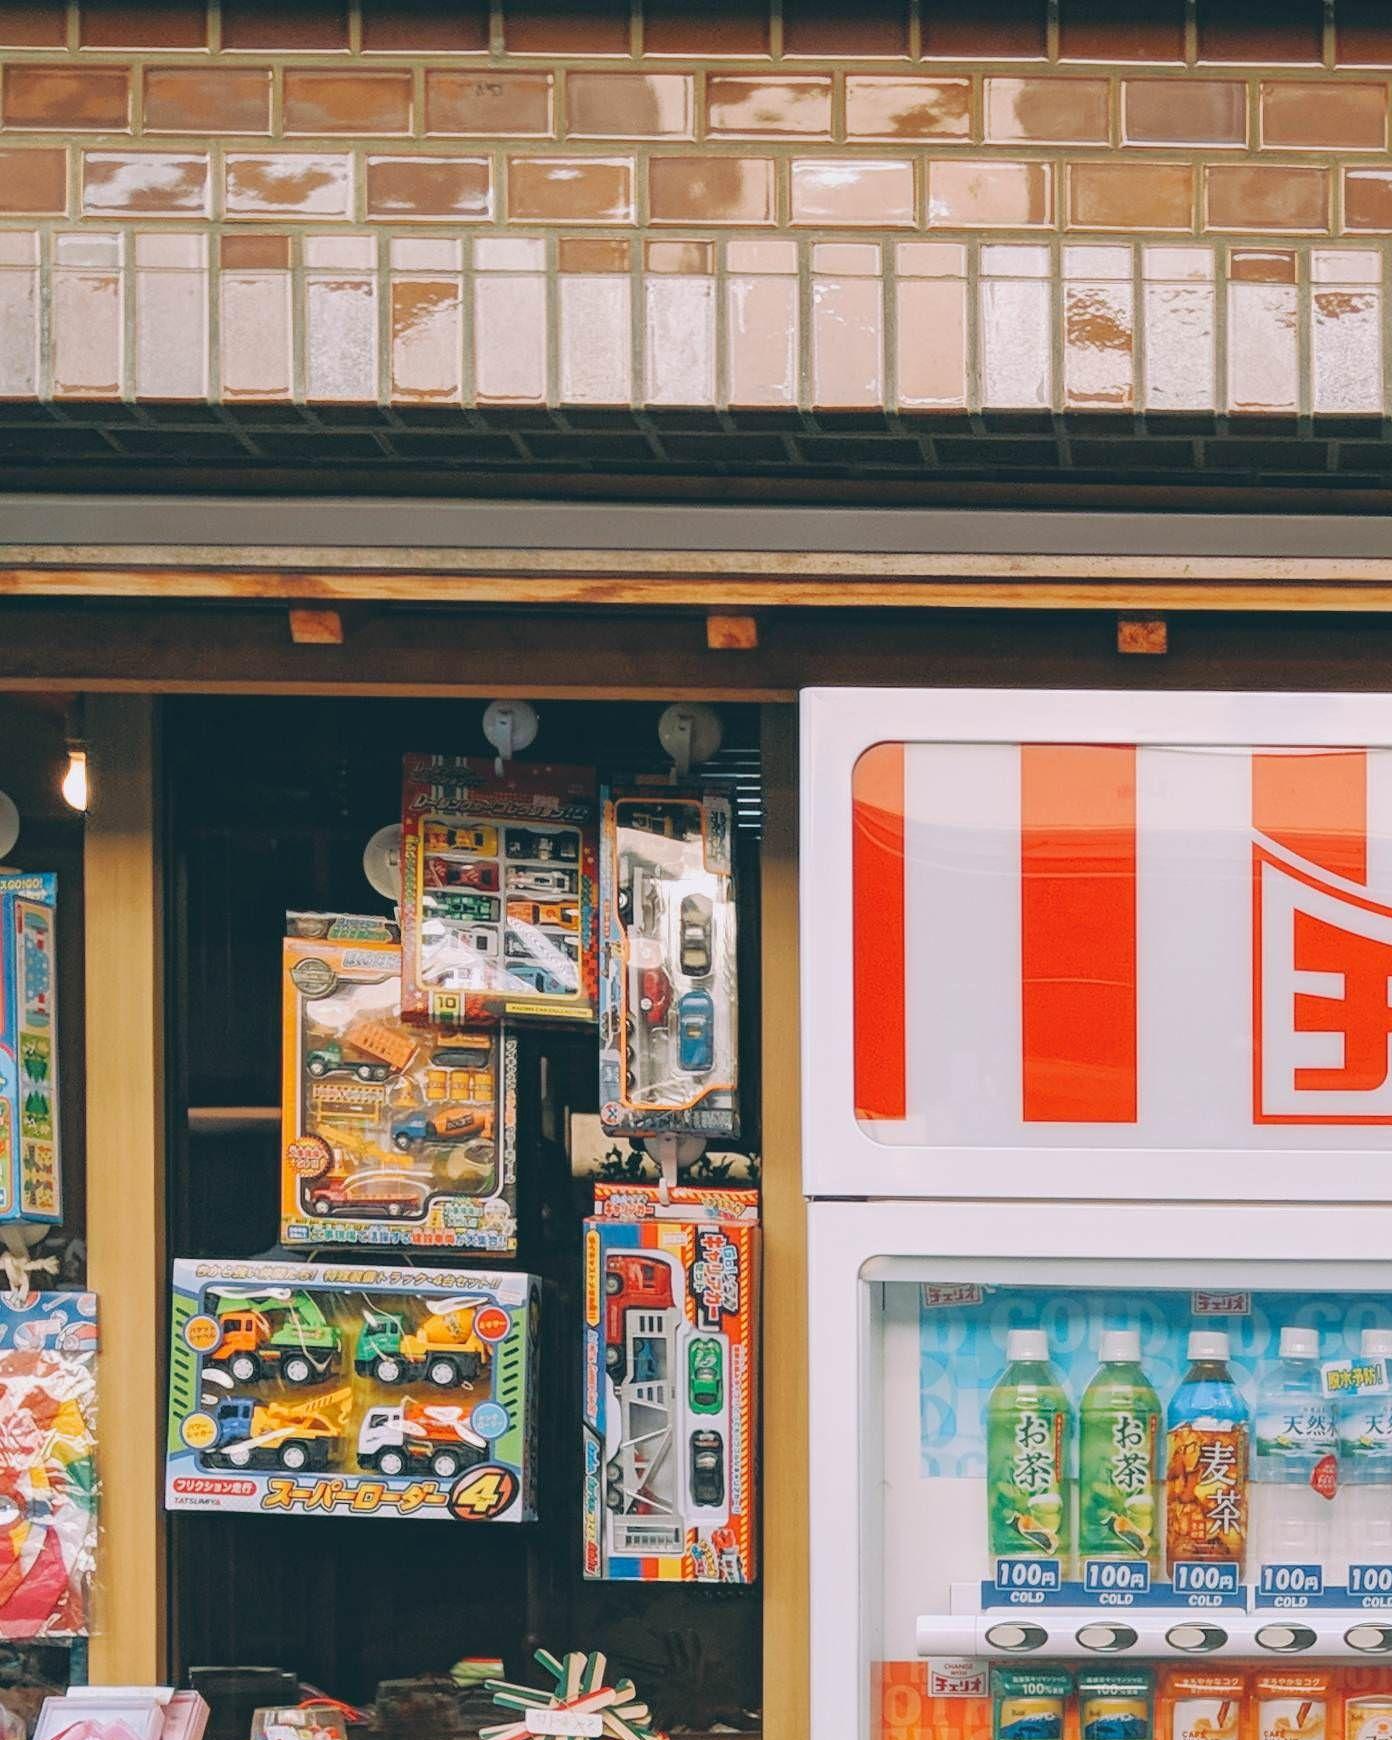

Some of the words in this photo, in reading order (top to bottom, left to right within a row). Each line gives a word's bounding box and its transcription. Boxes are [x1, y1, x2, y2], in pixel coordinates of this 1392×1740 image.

[437, 996, 456, 1009] 10
[1016, 1415, 1051, 1488] お茶
[1115, 1415, 1148, 1488] お茶
[263, 1476, 449, 1514] スーパーローダー
[457, 1472, 505, 1513] 4
[1199, 1442, 1241, 1535] 麦茶
[1000, 1564, 1056, 1586] 100円
[1089, 1566, 1144, 1588] 100円
[1178, 1567, 1233, 1589] 100円
[1264, 1568, 1318, 1591] 100円
[1010, 1592, 1045, 1603] COLD
[1100, 1593, 1134, 1605] COLD
[1189, 1595, 1222, 1607] COLD
[1275, 1597, 1309, 1608] COLD
[936, 1677, 981, 1693] チェリオ
